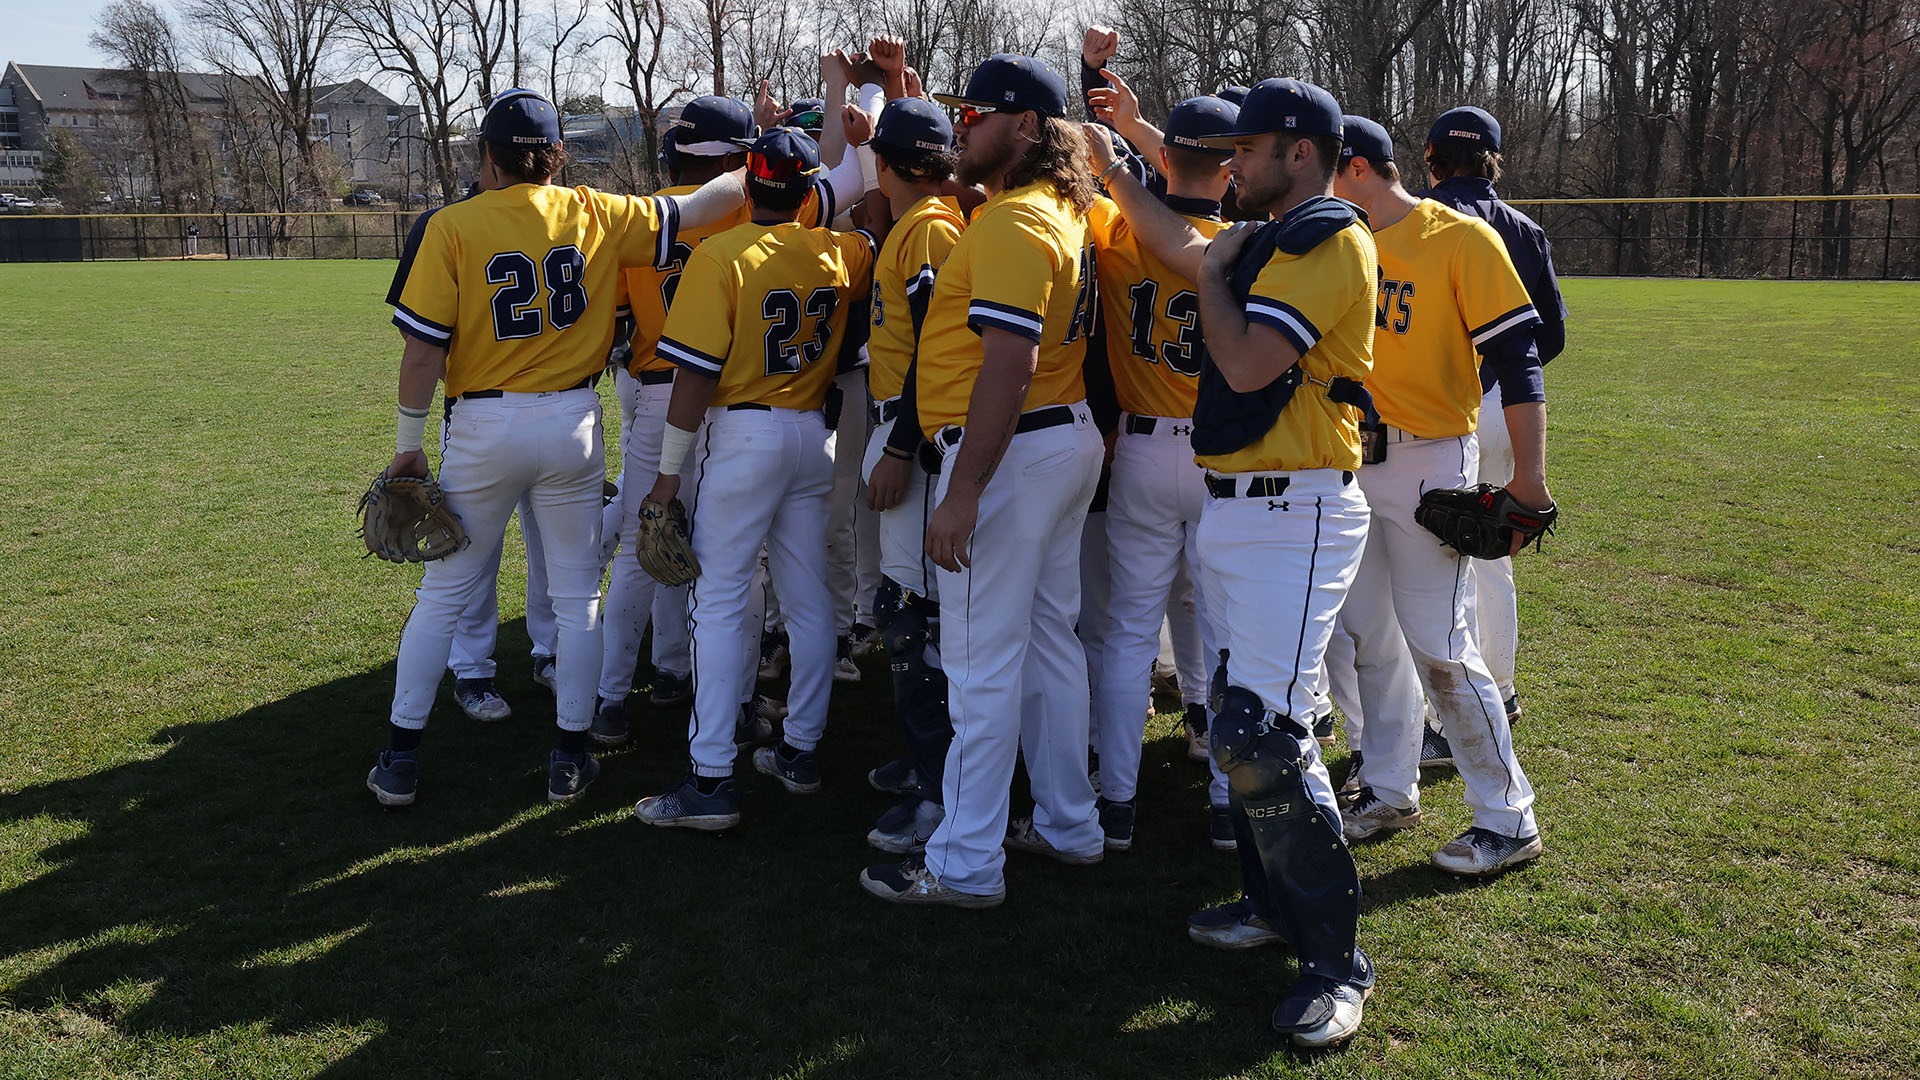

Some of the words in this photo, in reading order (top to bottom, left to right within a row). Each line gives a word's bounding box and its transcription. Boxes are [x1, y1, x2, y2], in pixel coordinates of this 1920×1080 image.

[512, 135, 548, 144] KNIGHTS
[1448, 129, 1481, 140] KNIGHTS
[754, 175, 786, 189] KNIGHTS
[484, 244, 588, 341] 28
[1377, 278, 1416, 335] TS
[762, 286, 840, 376] 23
[1128, 277, 1201, 377] 13
[1244, 803, 1290, 818] RCE3
